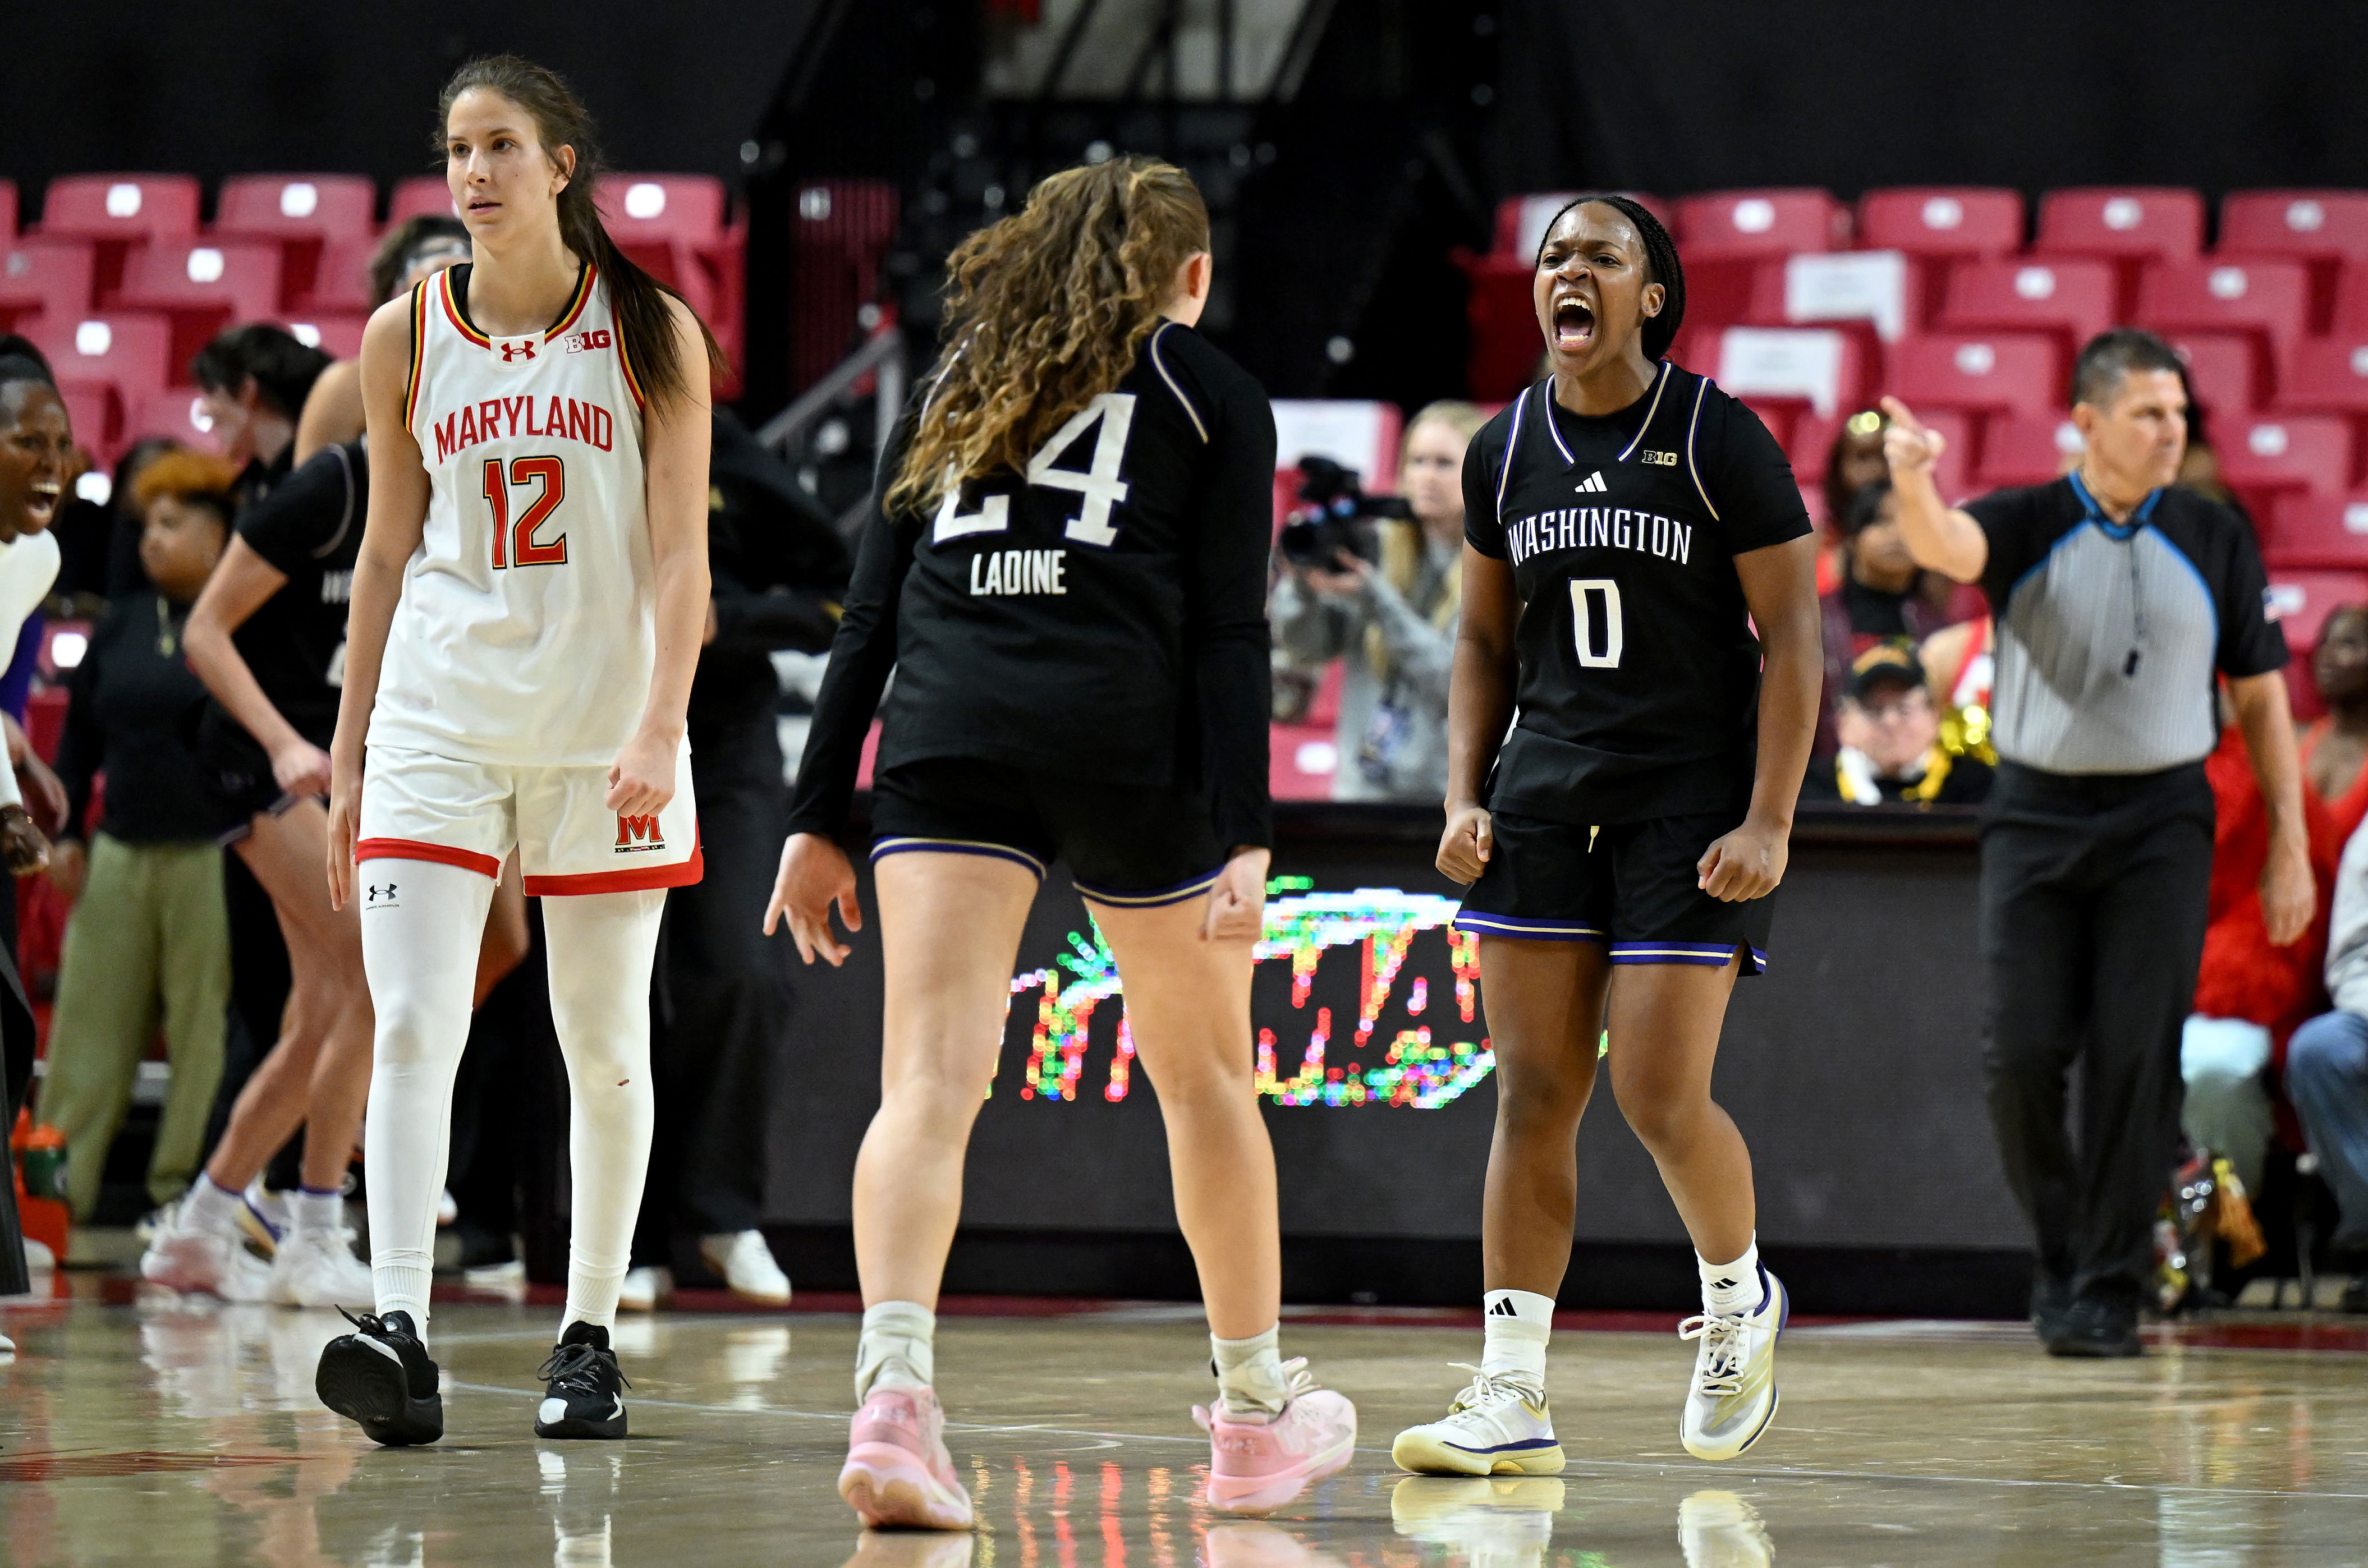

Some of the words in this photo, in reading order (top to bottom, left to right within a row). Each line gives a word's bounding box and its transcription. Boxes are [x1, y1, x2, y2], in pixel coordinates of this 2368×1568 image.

[434, 396, 613, 465] MARYLAND
[483, 455, 567, 569] 12
[1508, 507, 1692, 567] WASHINGTON
[970, 549, 1067, 595] LADINE
[1569, 578, 1624, 669] 0
[615, 810, 664, 845] M
